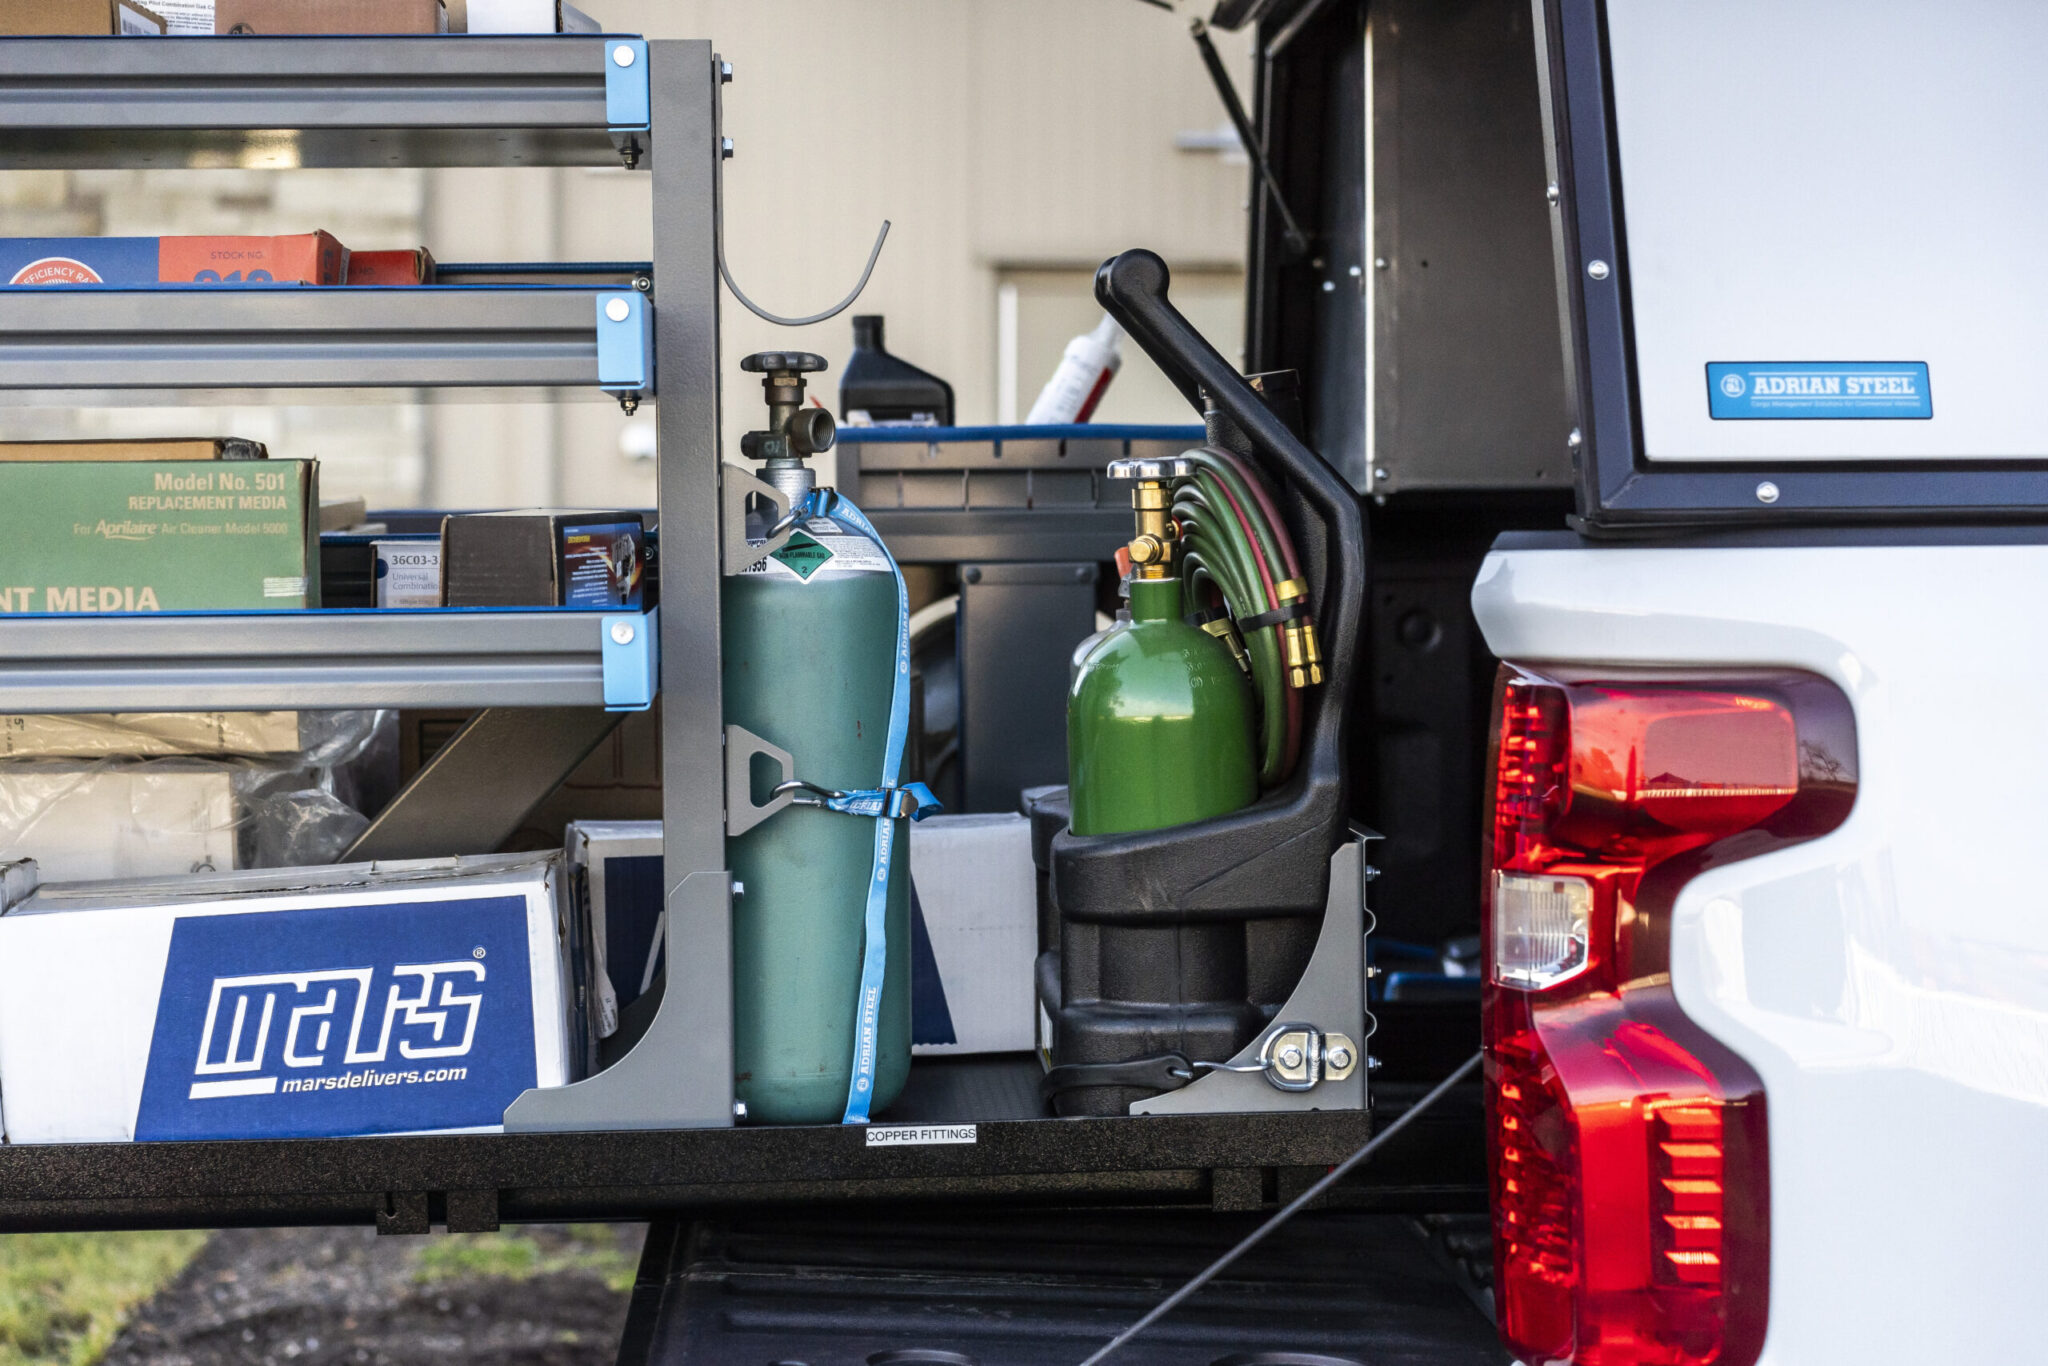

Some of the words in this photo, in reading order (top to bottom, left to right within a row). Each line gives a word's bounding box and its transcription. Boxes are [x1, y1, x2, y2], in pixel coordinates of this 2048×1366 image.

[211, 251, 244, 260] STOCK
[1754, 376, 1840, 395] ADRIAN
[1846, 376, 1915, 395] STEEL
[154, 472, 214, 491] Model
[219, 472, 250, 491] No.
[255, 472, 285, 491] 501
[129, 496, 234, 511] REPLACEMENT
[239, 495, 288, 510] MEDIA
[73, 523, 91, 536] For
[95, 519, 157, 539] Aprilaire
[161, 522, 178, 535] Air
[180, 522, 222, 535] Cleaner
[225, 522, 260, 535] Model
[392, 572, 429, 581] Universal
[801, 566, 808, 574] 2
[47, 586, 161, 612] MEDIA
[864, 986, 877, 1025] STEEL
[195, 961, 486, 1075] mars
[860, 1026, 872, 1075] ADRIAN
[282, 1067, 468, 1093] marsdelivers.com
[866, 1131, 918, 1142] COPPER
[921, 1128, 976, 1140] FITTINGS
